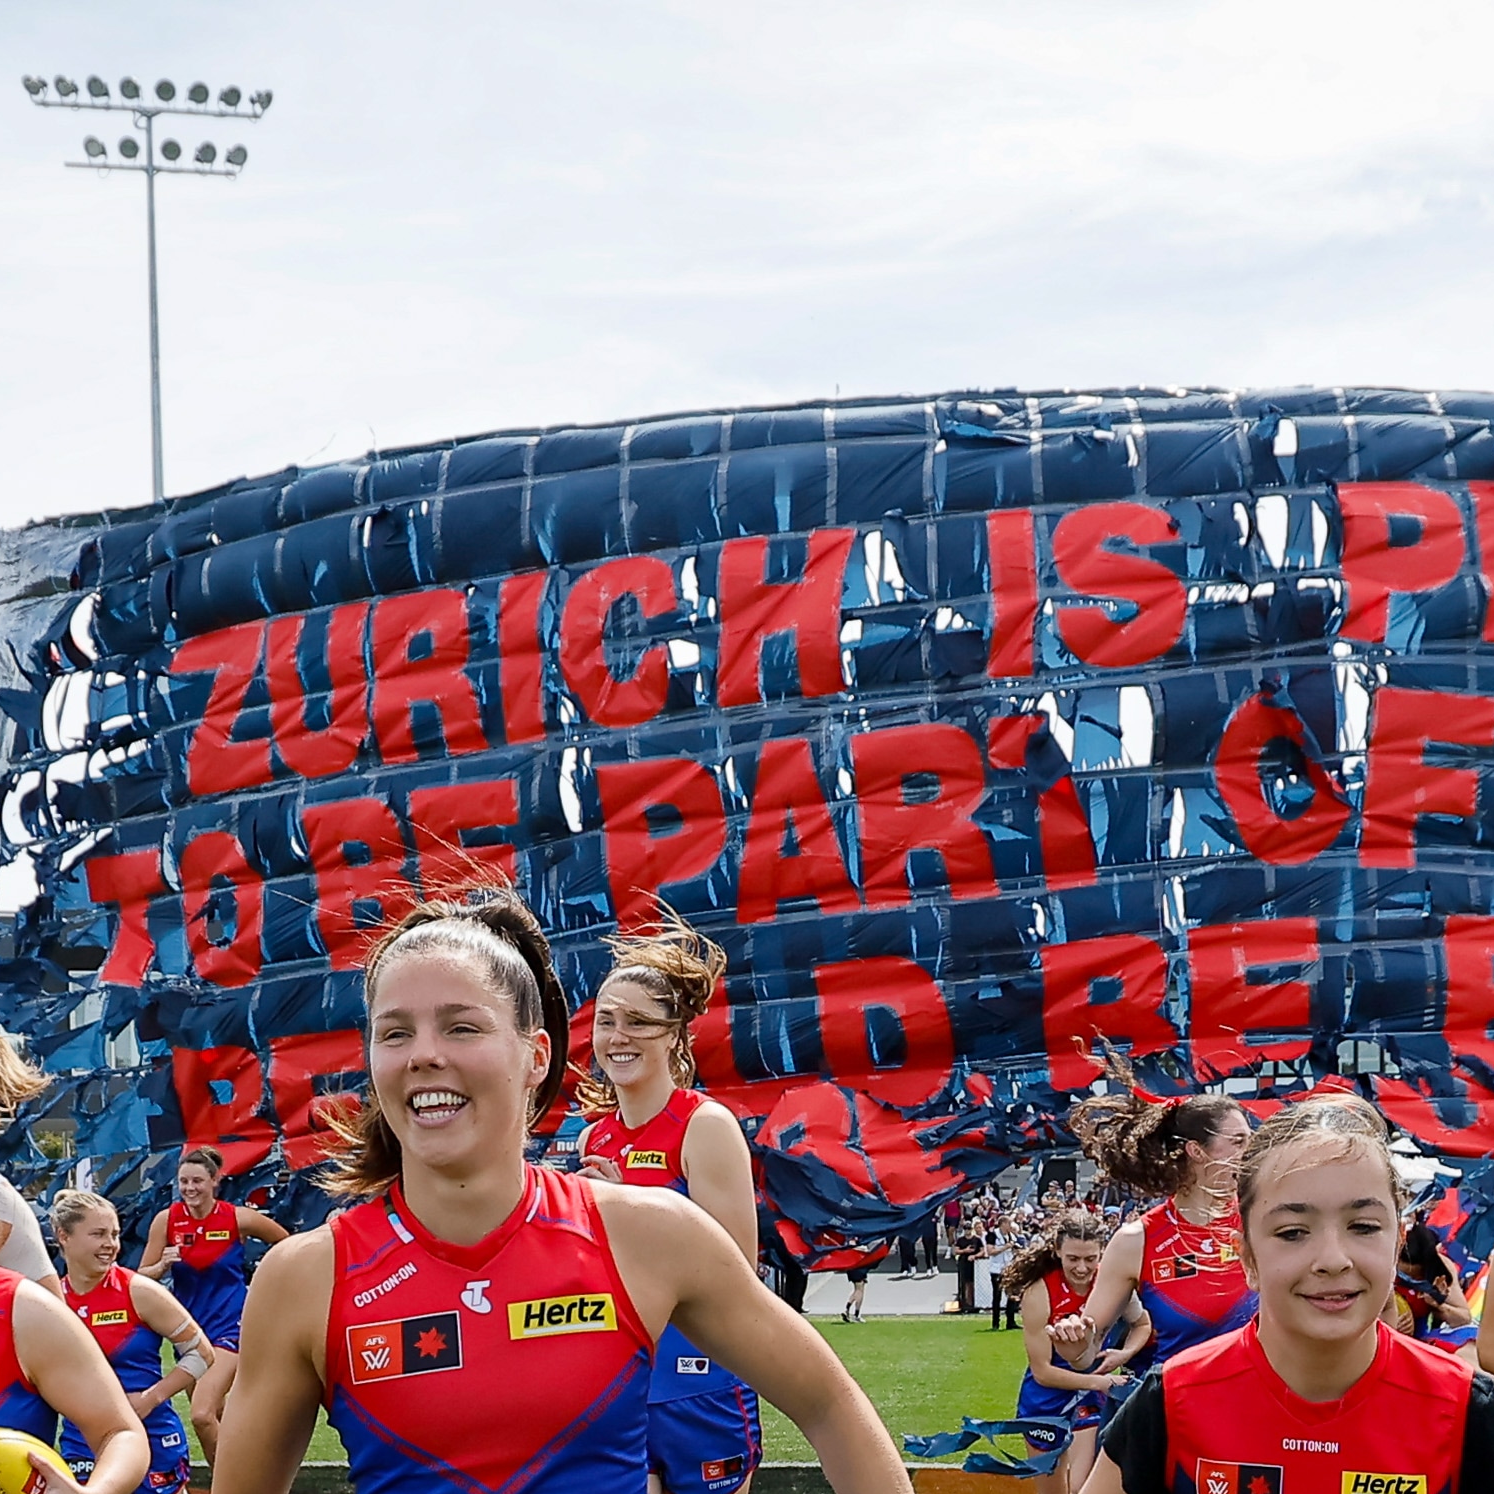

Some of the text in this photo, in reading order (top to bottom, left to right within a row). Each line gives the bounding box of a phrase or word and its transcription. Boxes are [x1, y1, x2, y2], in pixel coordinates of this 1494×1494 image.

[171, 527, 858, 796] ZURICH
[985, 500, 1189, 680] IS
[87, 831, 265, 990] TO
[301, 778, 519, 972] BE
[631, 1151, 663, 1165] Hertz
[95, 1311, 125, 1323] Hertz
[523, 1298, 606, 1329] Hertz
[1283, 1437, 1340, 1454] COTTON:ON
